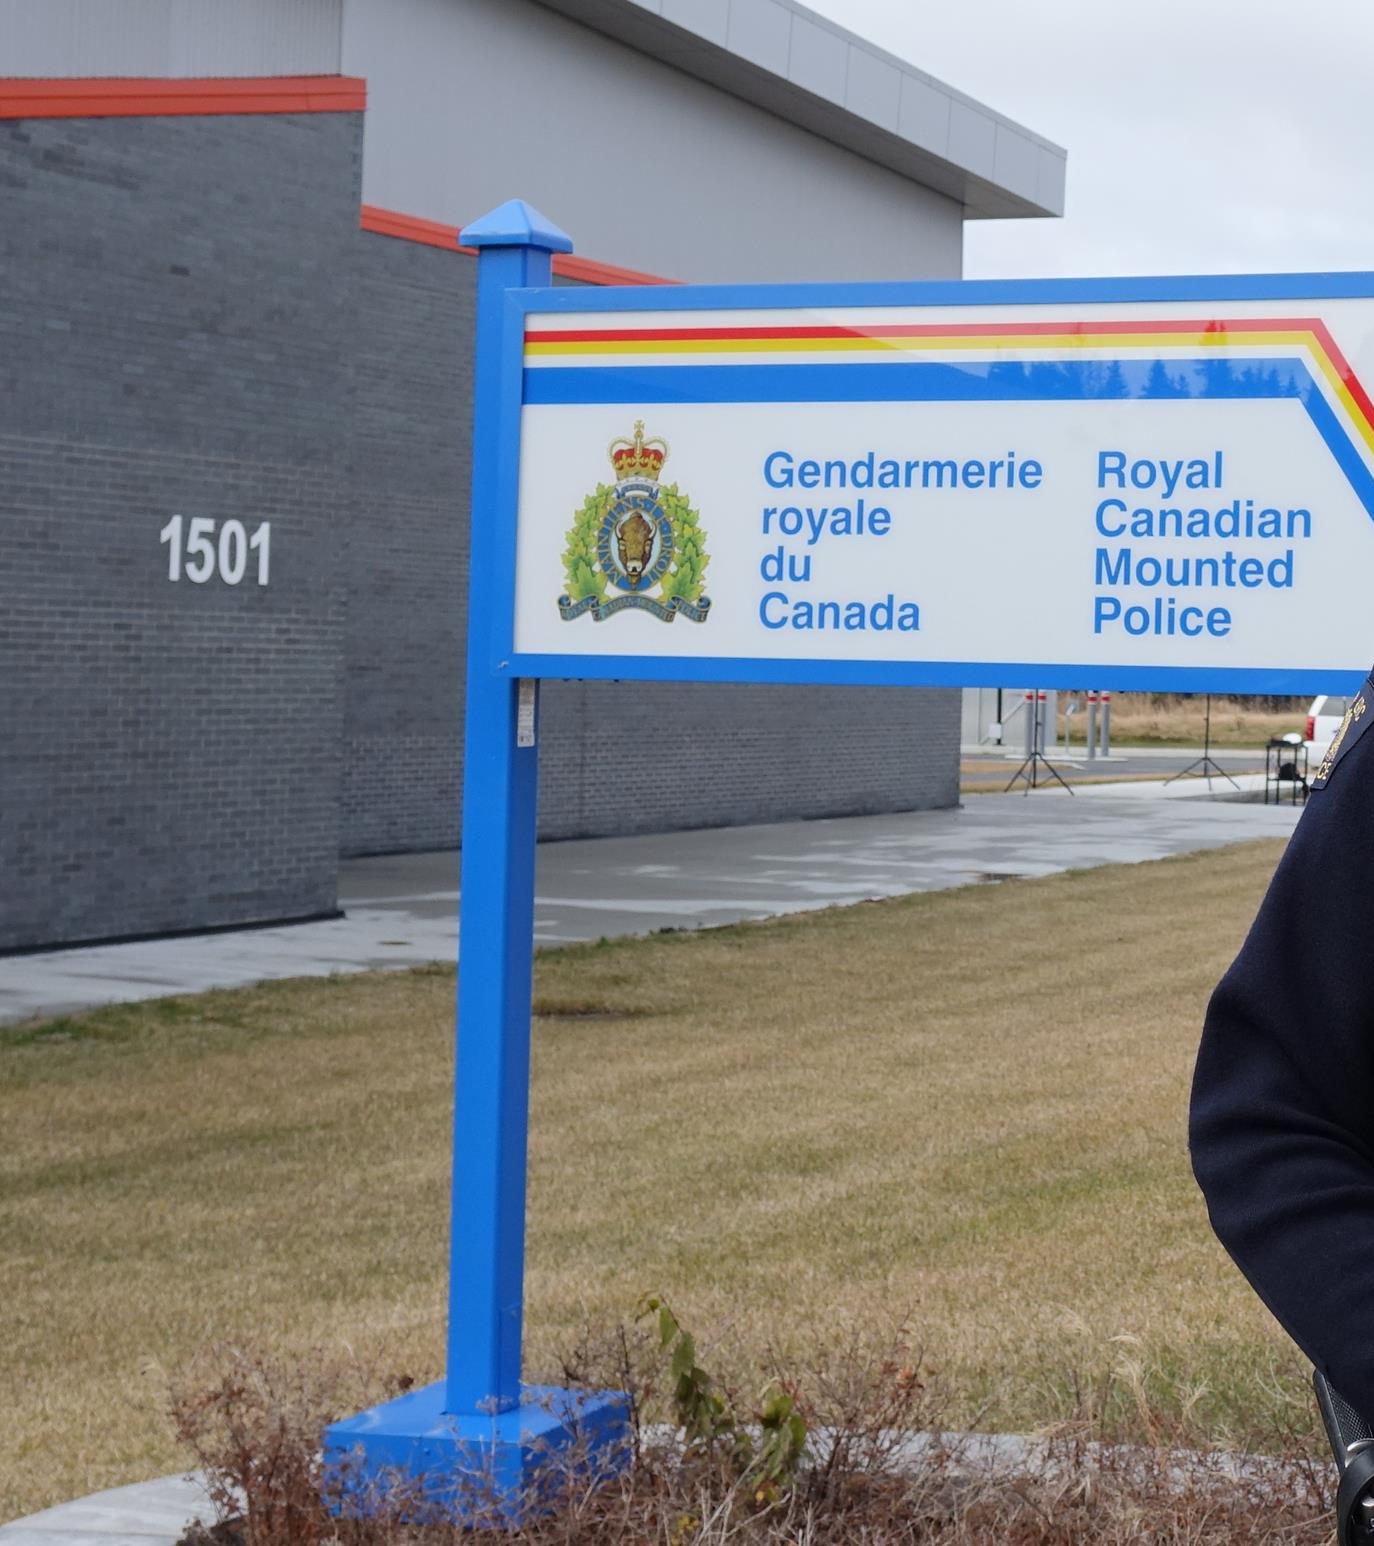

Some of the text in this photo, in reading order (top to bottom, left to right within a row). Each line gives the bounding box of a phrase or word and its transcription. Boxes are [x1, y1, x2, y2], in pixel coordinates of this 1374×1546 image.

[762, 450, 1043, 490] Gendarmerie
[1096, 449, 1225, 501] Royal
[760, 498, 893, 546] royale
[1094, 498, 1313, 540] Canadian
[160, 514, 271, 586] 1501
[759, 544, 813, 584] du
[1094, 546, 1295, 590] Mounted
[758, 591, 922, 634] Canada
[1093, 594, 1233, 638] Police
